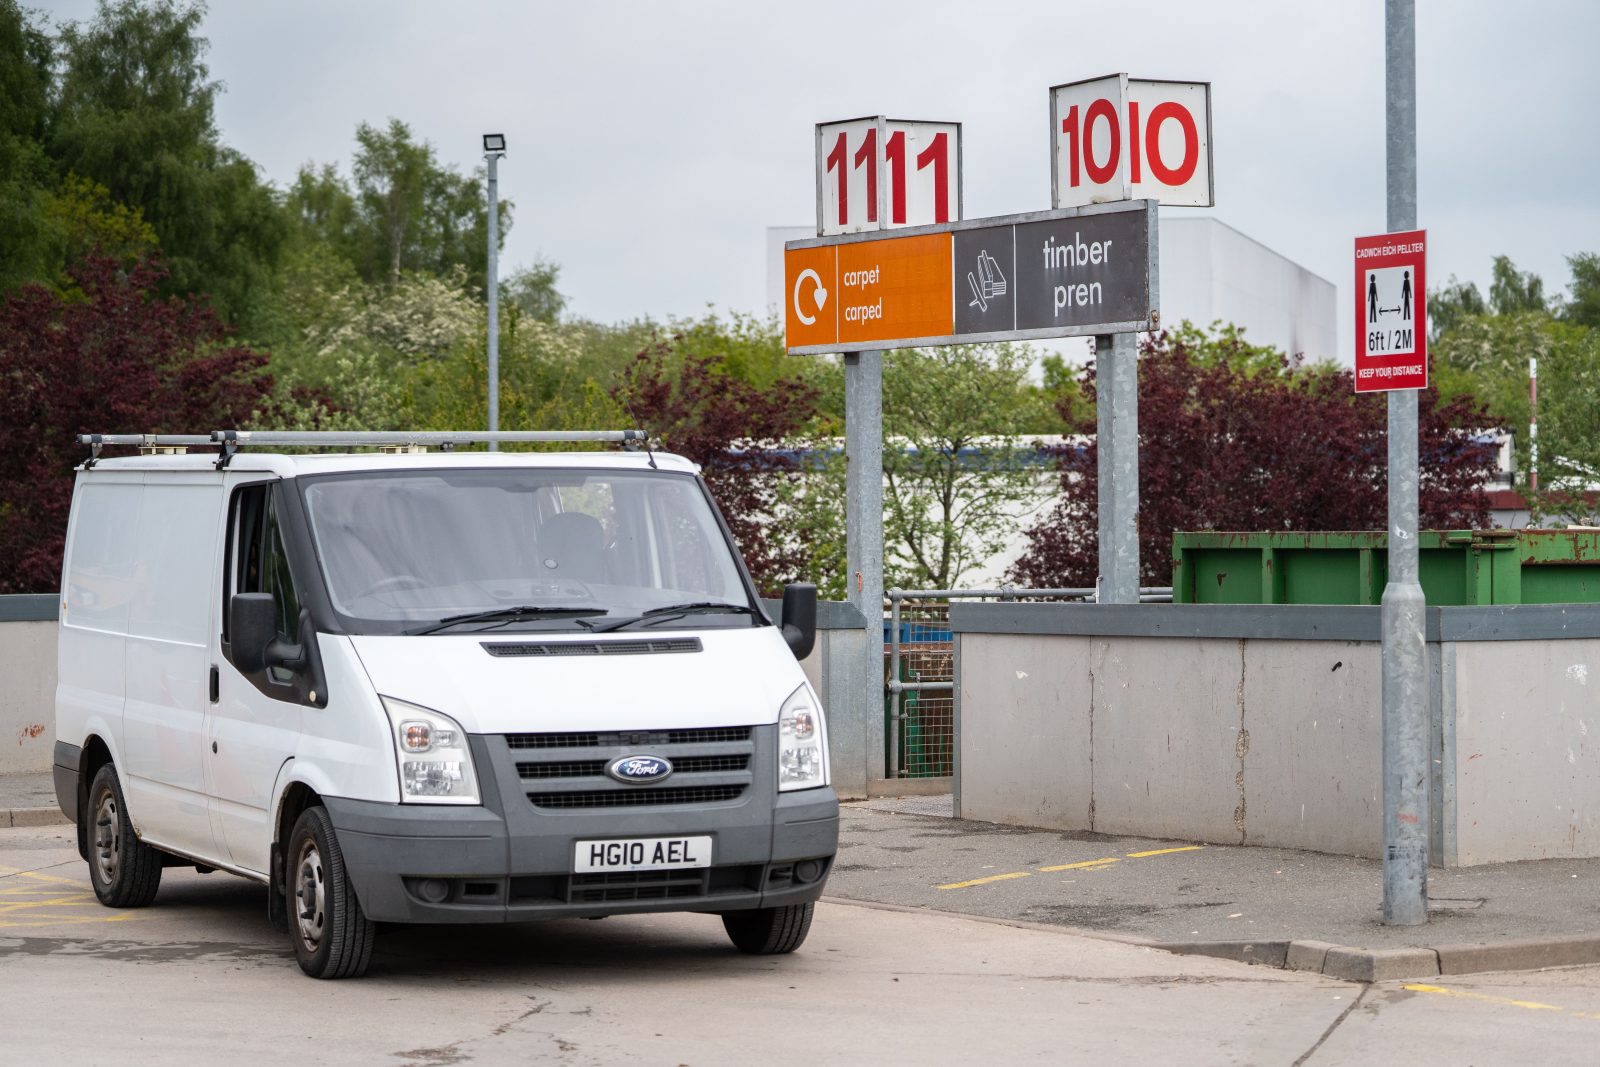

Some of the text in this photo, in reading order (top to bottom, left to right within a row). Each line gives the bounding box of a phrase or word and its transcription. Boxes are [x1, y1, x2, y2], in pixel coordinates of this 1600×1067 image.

[1062, 98, 1121, 188] 10
[1129, 101, 1199, 187] 10
[827, 127, 878, 226] 11
[885, 130, 949, 225] 11
[1042, 231, 1112, 269] timber
[1356, 242, 1424, 259] CADWCH EICH PELLTER
[843, 264, 880, 291] carpet
[845, 296, 883, 326] carped
[1054, 280, 1102, 317] pren
[1368, 331, 1385, 351] 6ft
[1394, 328, 1412, 350] 2M
[1359, 364, 1422, 378] KEEP YOUR DISTANCE
[626, 760, 659, 776] Ford
[590, 840, 697, 867] HG10 AEL
